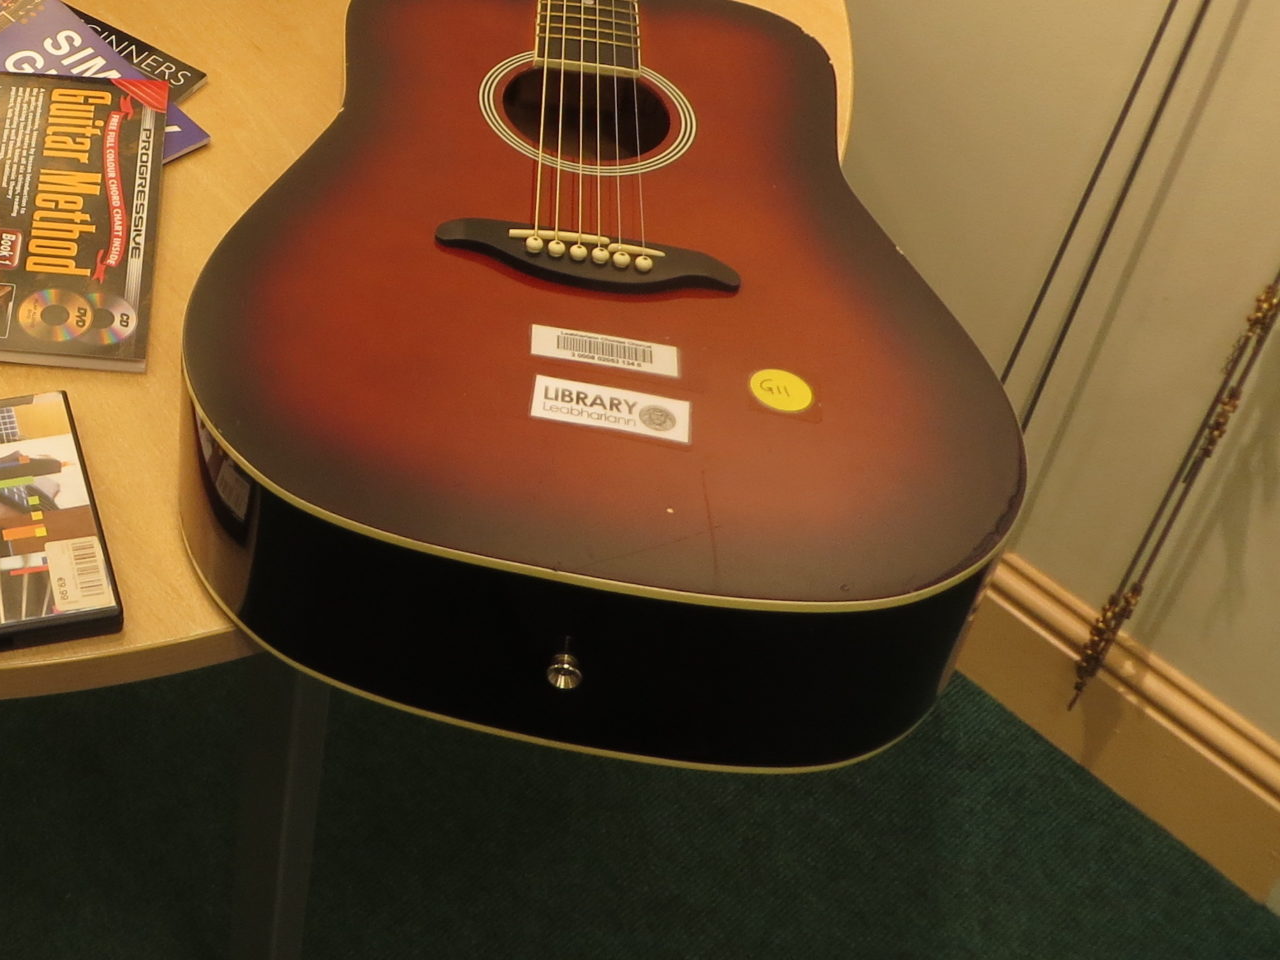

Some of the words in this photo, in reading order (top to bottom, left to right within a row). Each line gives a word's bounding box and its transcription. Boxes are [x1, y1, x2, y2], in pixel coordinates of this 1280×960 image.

[88, 24, 191, 86] INNERS
[42, 87, 112, 165] Guitar
[108, 114, 120, 131] FREE
[106, 131, 118, 148] FULL
[104, 148, 116, 177] COLOUR
[109, 179, 120, 206] CHORD
[130, 127, 152, 259] PROGRESSIVE
[25, 167, 102, 277] Method
[112, 208, 122, 236] CHART
[0, 233, 15, 256] Book
[106, 237, 121, 265] INSIDE
[74, 306, 87, 327] DVD
[119, 312, 130, 327] CD
[544, 386, 638, 415] LIBRARY
[760, 378, 790, 397] G11
[543, 401, 637, 427] Leabharlann
[57, 577, 69, 600] €9.99
